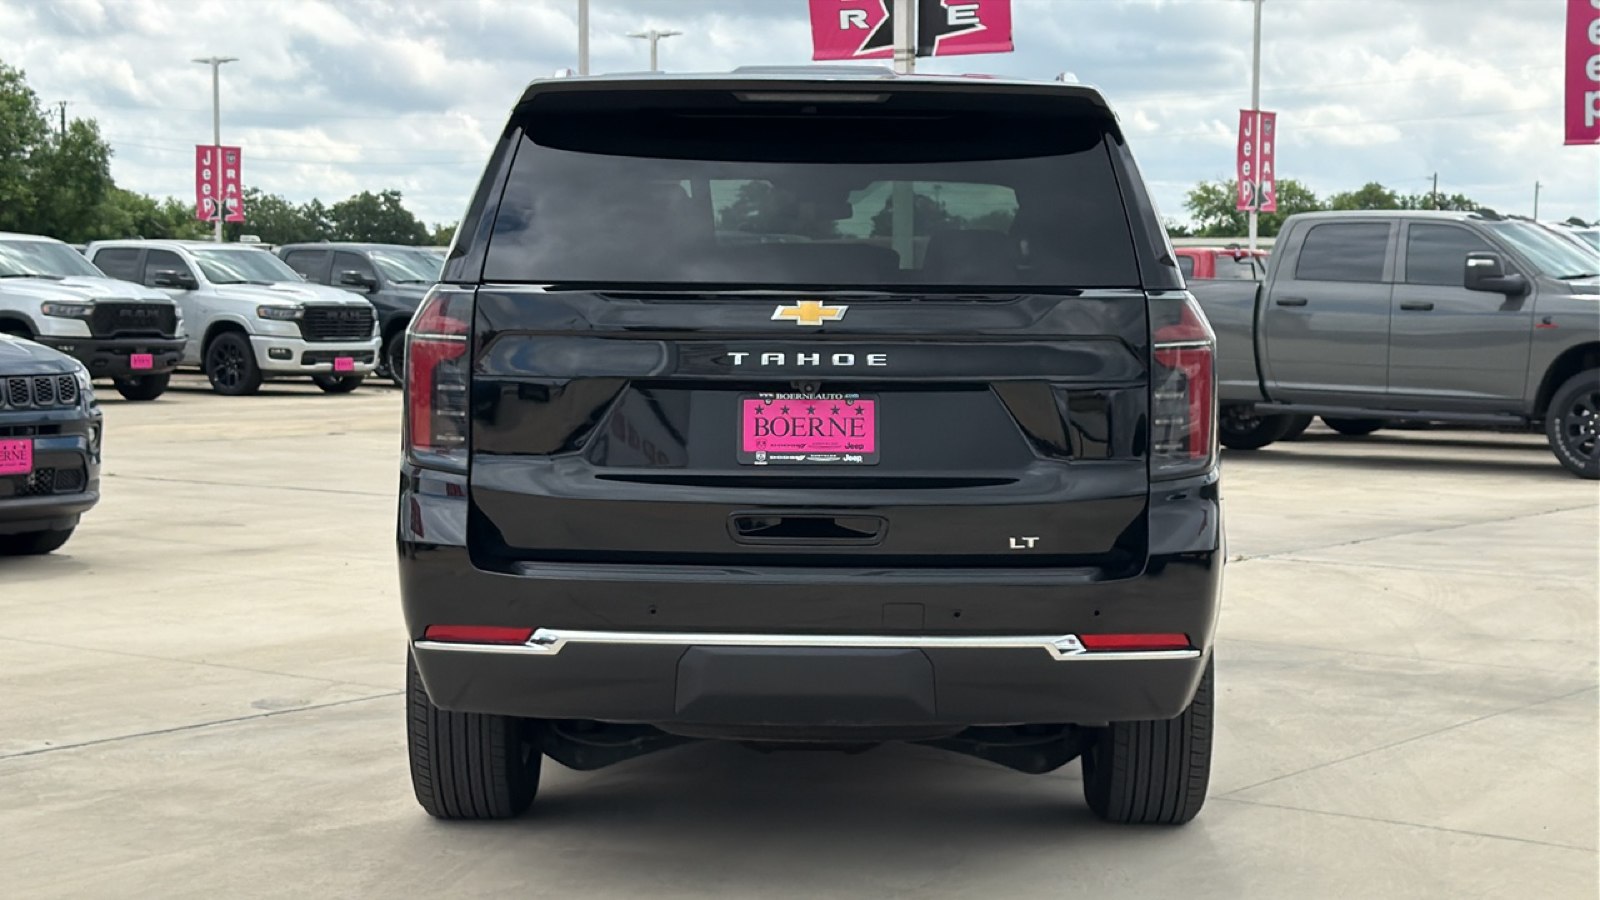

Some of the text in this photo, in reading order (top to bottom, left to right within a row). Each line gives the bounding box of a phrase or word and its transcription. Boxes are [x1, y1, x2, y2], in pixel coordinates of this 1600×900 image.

[1242, 116, 1252, 201] Jeep
[202, 149, 212, 213] Jeep
[226, 168, 237, 208] RAM
[727, 352, 887, 366] TAHOE
[754, 416, 866, 438] BOERNE
[844, 442, 865, 450] Jeep
[1010, 537, 1040, 549] LT
